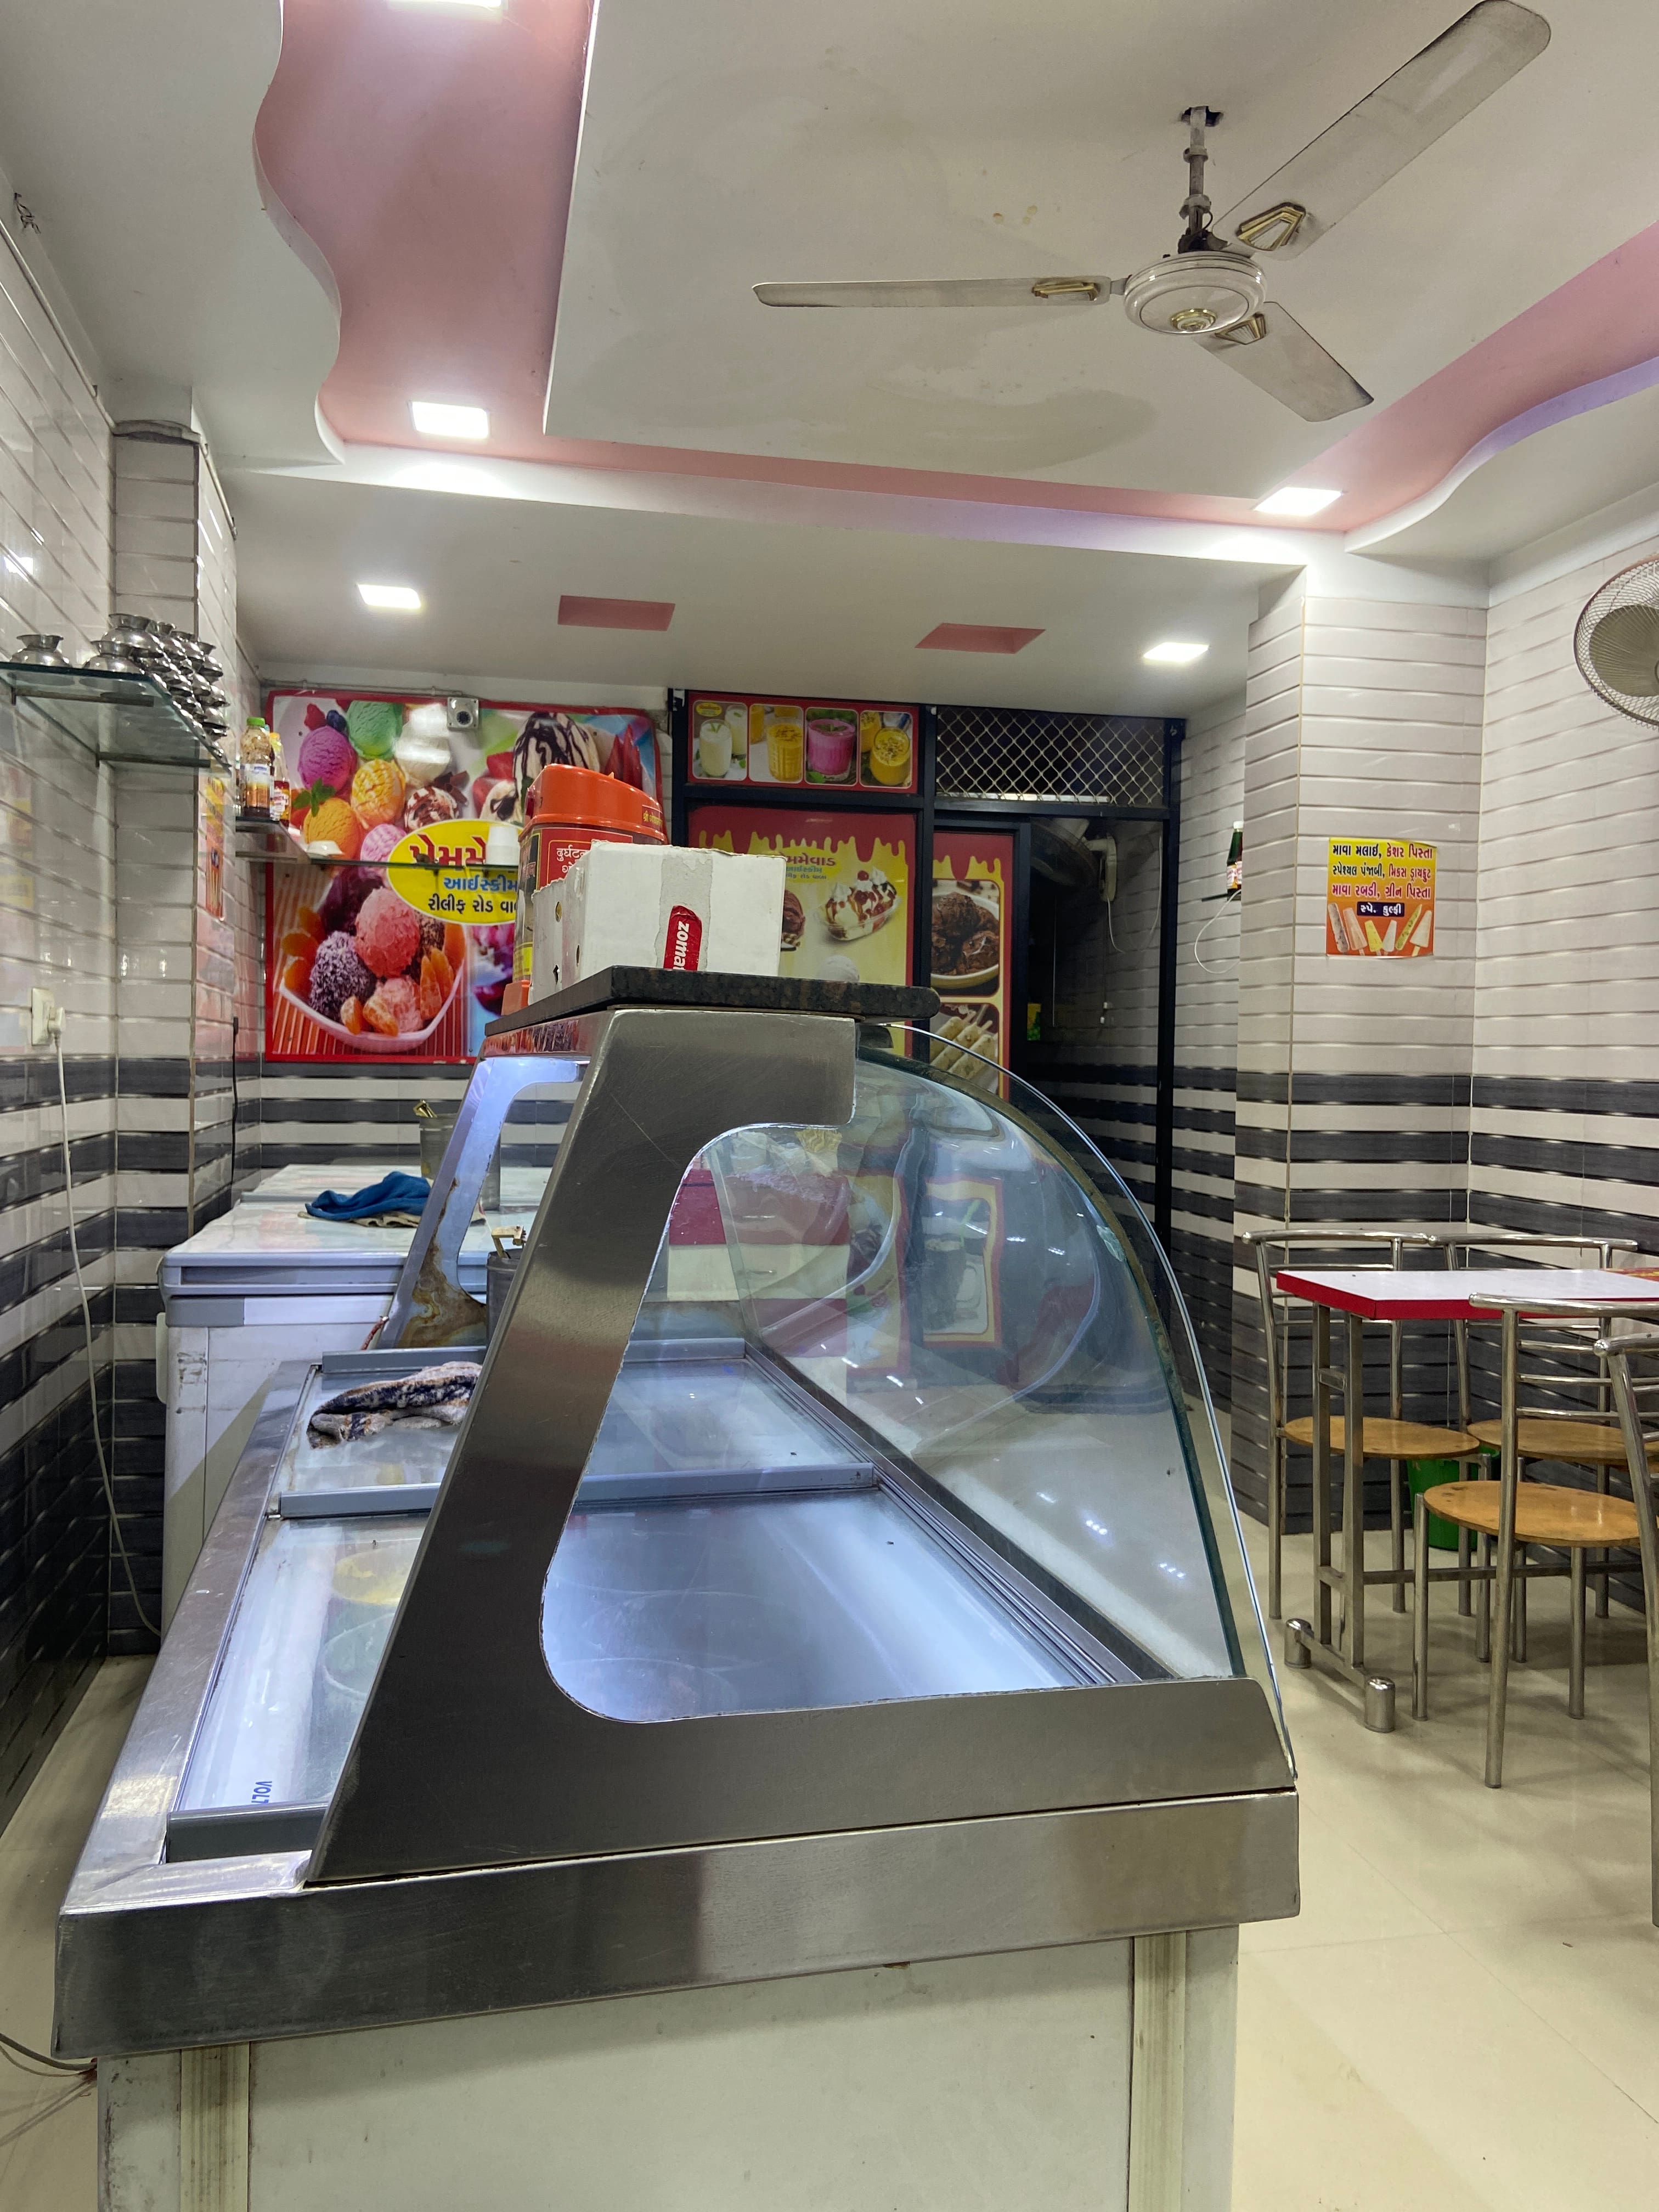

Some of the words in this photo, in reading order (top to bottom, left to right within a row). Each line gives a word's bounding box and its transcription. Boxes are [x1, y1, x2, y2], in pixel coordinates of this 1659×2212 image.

[1333, 845, 1351, 855] માવા
[1387, 843, 1404, 857] કેશર
[1409, 843, 1432, 859] પિસ્તા
[1333, 861, 1357, 876] સ્પેશ્યલ
[1332, 884, 1351, 895] માવા
[1355, 882, 1380, 898] રબડી,
[1385, 882, 1402, 897] ગ્રીન
[1407, 883, 1430, 898] પિસ્તા
[428, 893, 465, 914] રીલીફ
[472, 894, 493, 912] રોડ
[251, 1780, 272, 1804] VOLT
